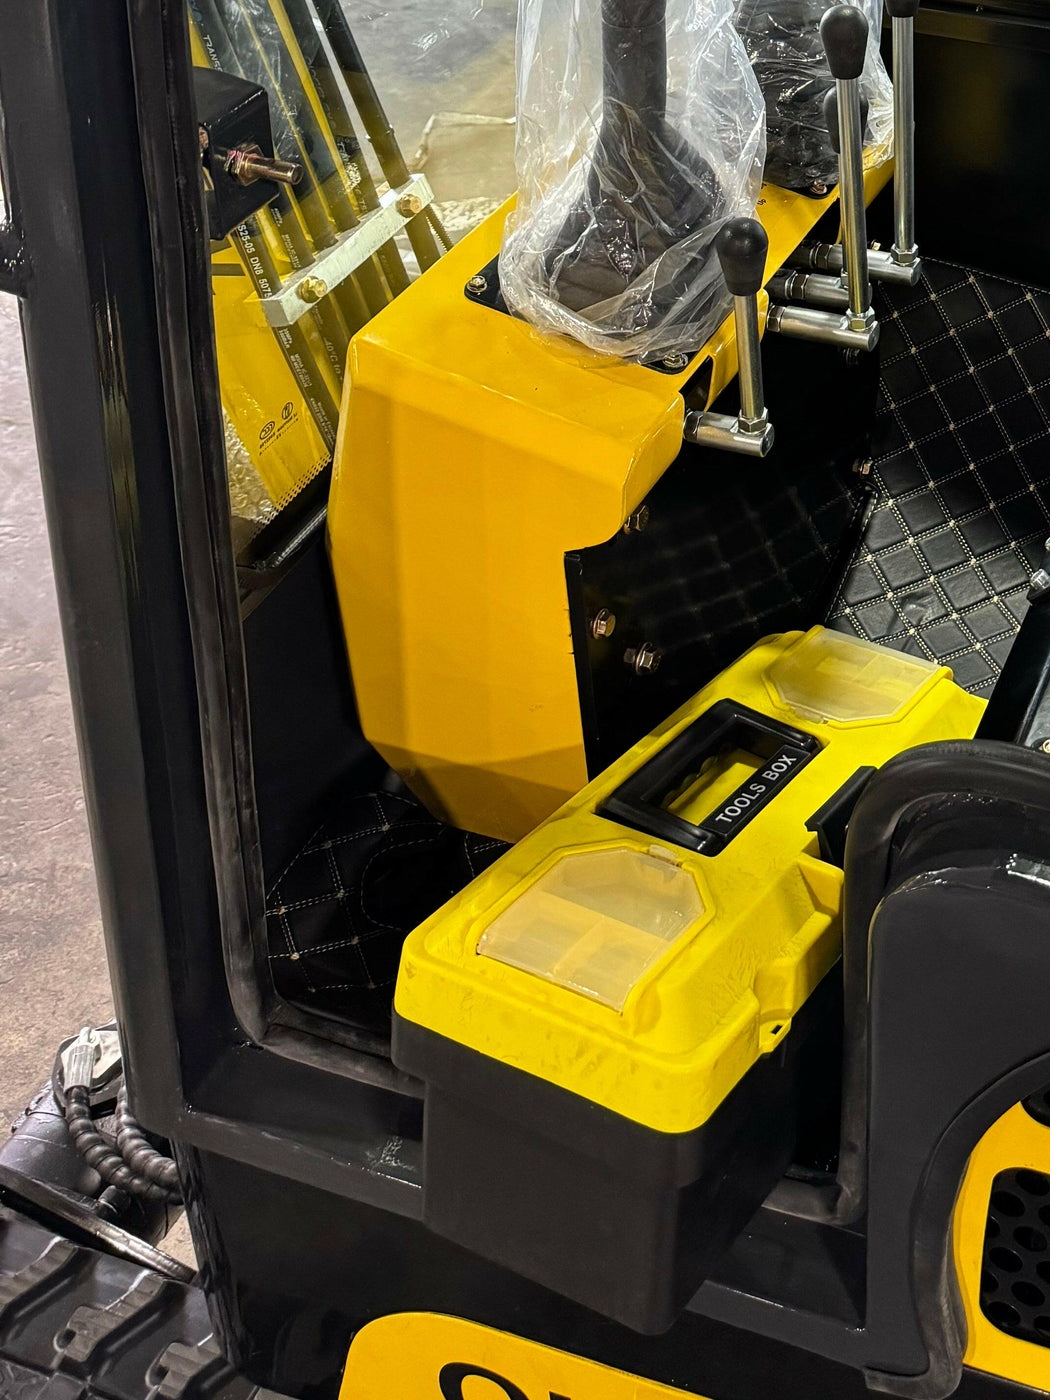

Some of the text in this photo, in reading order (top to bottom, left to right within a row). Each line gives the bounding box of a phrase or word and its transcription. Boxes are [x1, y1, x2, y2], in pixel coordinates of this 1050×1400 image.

[250, 256, 263, 276] DN8
[715, 754, 797, 823] TOOLS BOX
